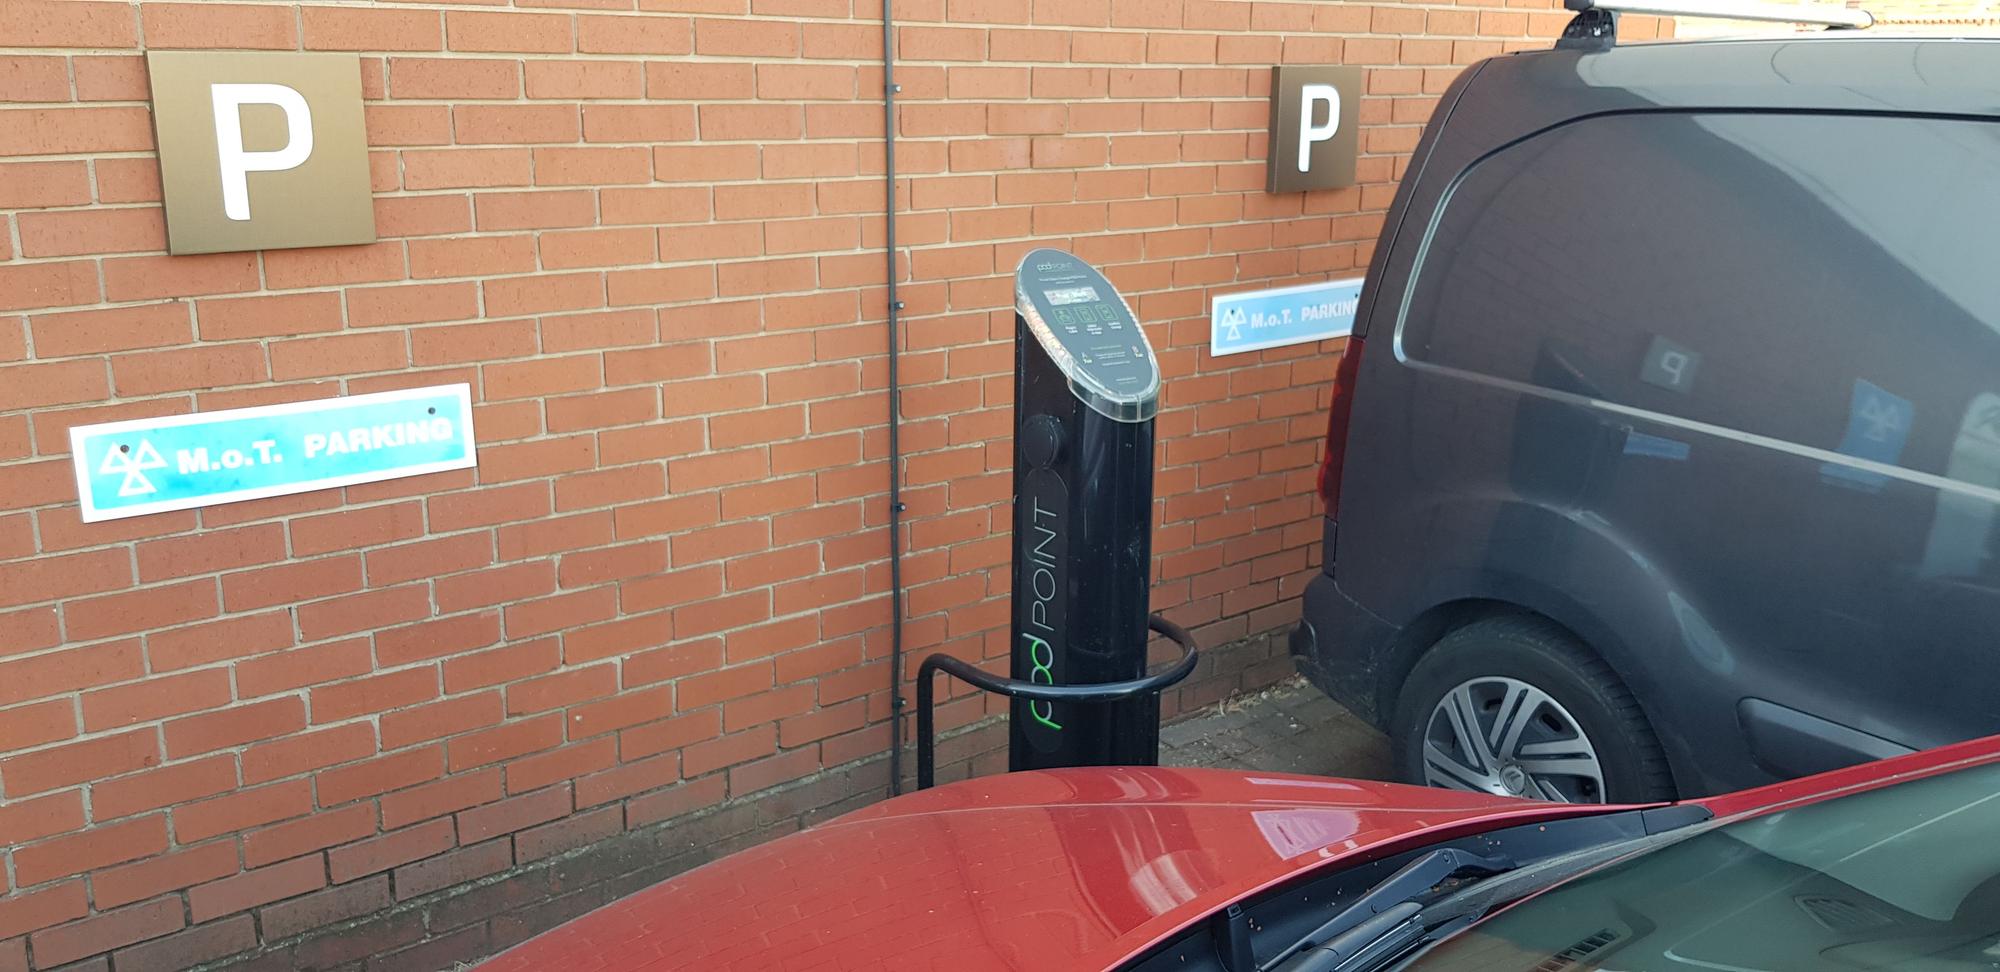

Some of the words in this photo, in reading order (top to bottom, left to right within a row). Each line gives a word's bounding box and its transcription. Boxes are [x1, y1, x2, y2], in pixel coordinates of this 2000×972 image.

[211, 83, 314, 221] P
[1298, 84, 1340, 172] P
[1251, 308, 1292, 328] M.o.T.
[176, 438, 283, 475] M.o.T.
[304, 417, 454, 459] PARKING
